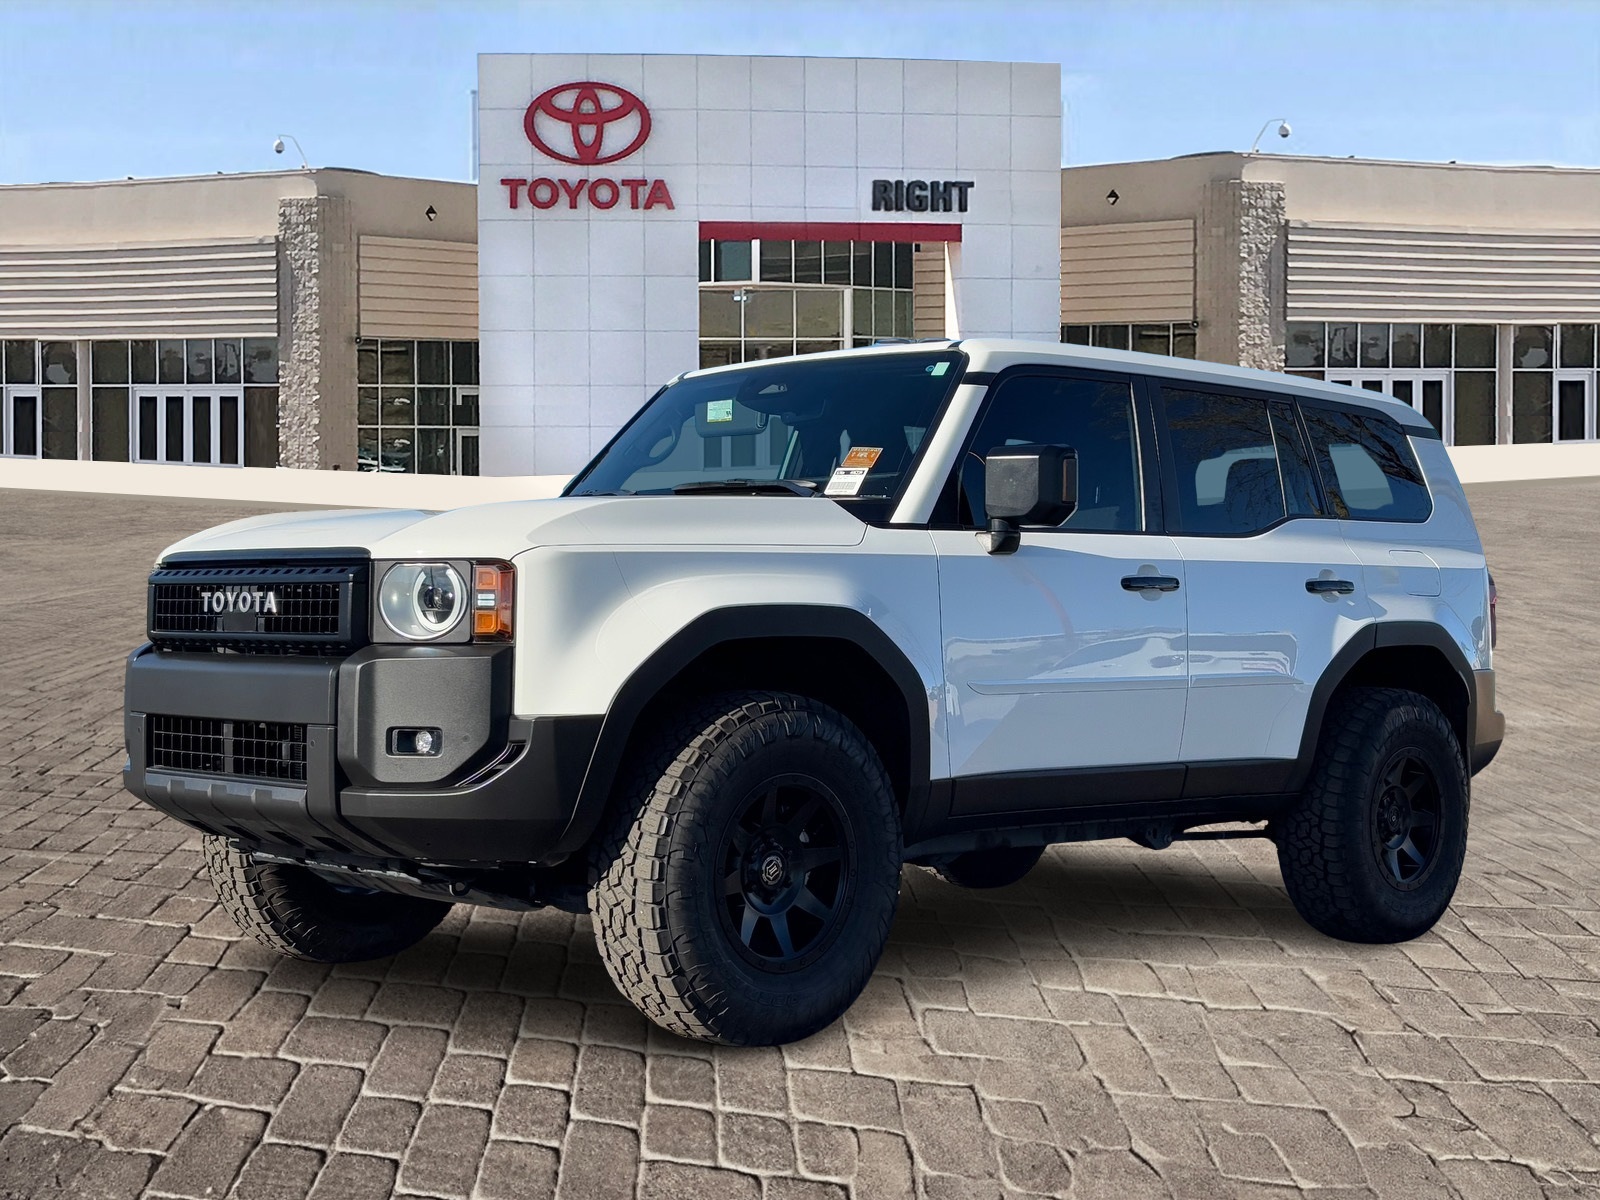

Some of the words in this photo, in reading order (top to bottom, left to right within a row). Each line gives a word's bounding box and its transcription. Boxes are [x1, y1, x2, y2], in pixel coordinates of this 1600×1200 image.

[501, 178, 675, 210] TOYOTA
[872, 180, 974, 212] RIGHT
[201, 591, 277, 613] TOYOTA
